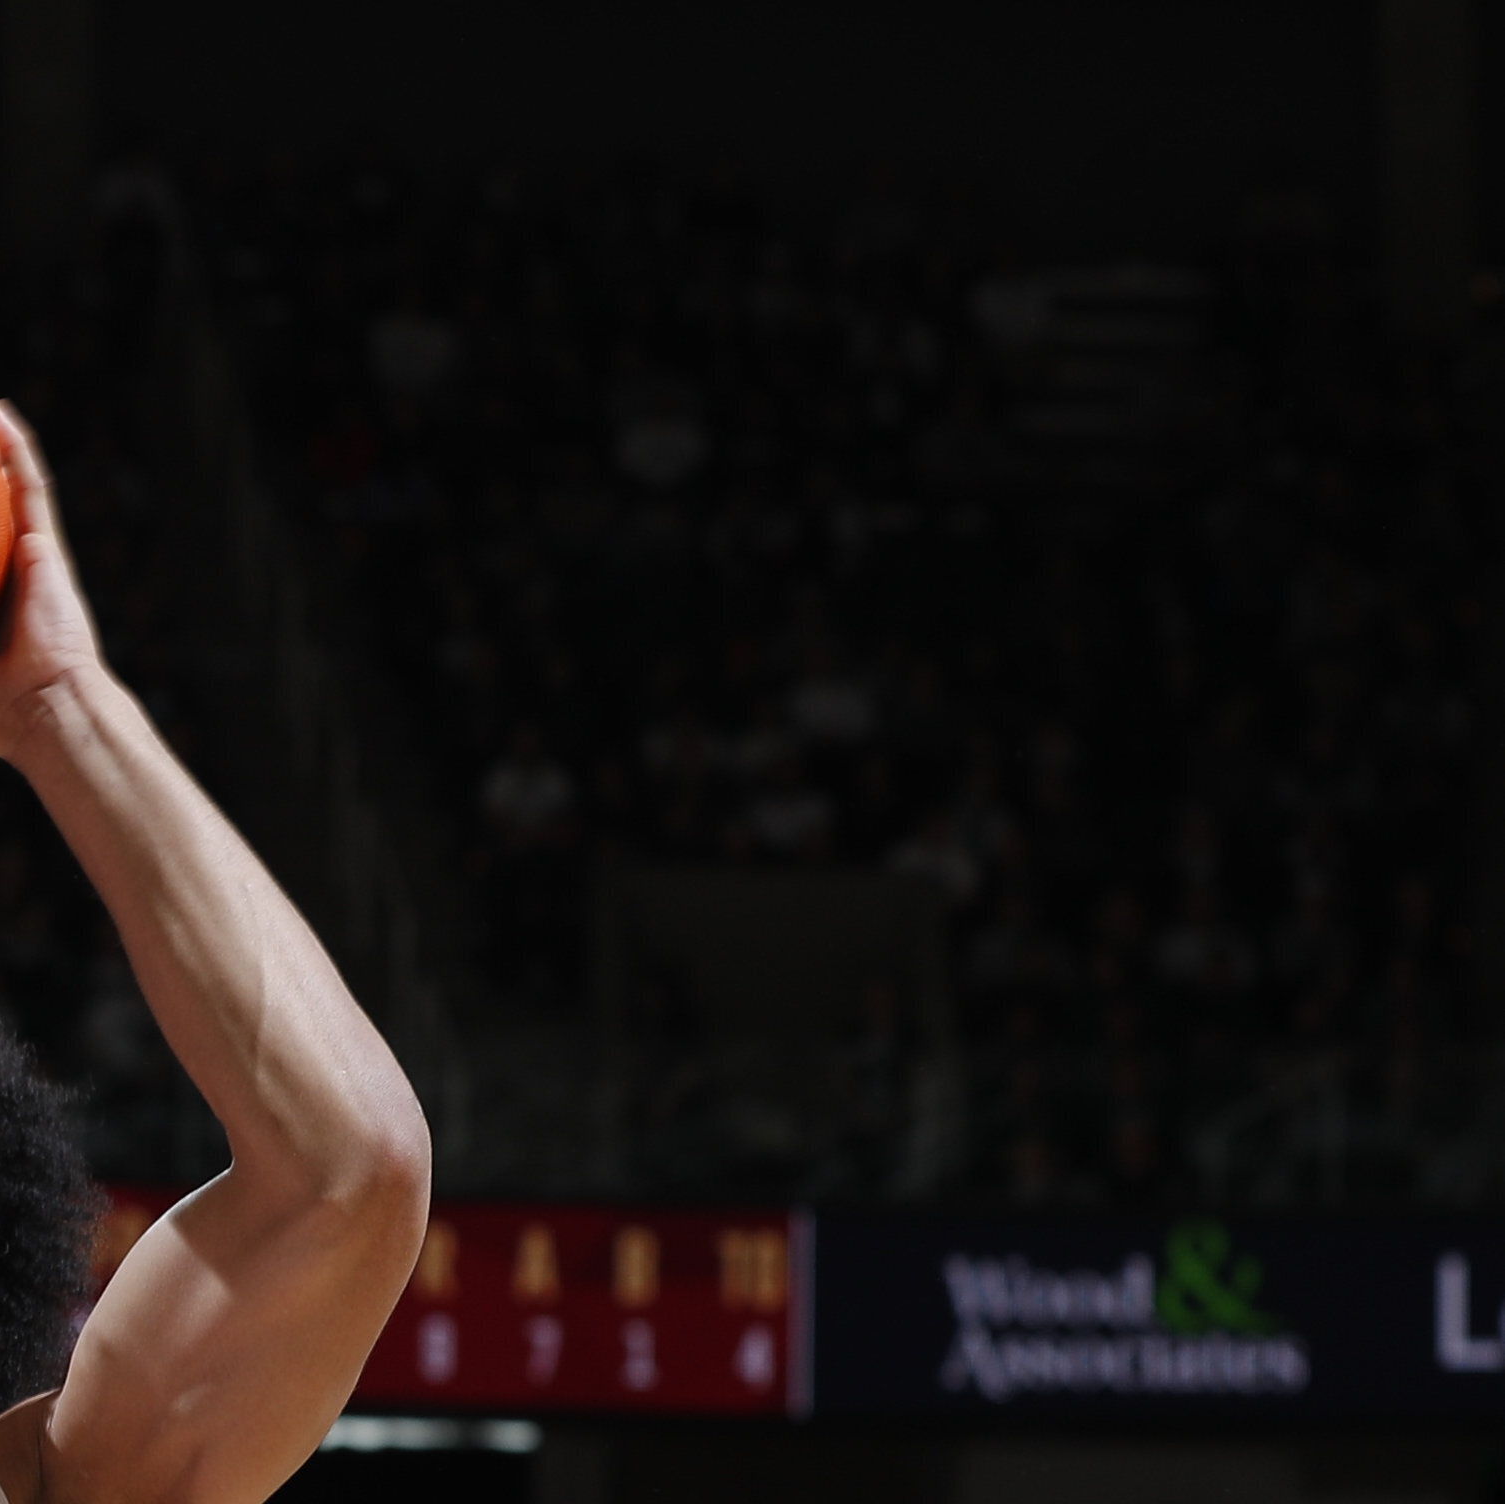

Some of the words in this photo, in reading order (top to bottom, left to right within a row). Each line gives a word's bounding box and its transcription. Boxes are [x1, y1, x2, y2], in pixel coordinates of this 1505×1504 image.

[515, 1225, 561, 1302] A
[942, 1252, 1155, 1328] Wood
[1157, 1216, 1291, 1336] &
[1435, 1250, 1505, 1371] L
[940, 1325, 1310, 1402] Associates
